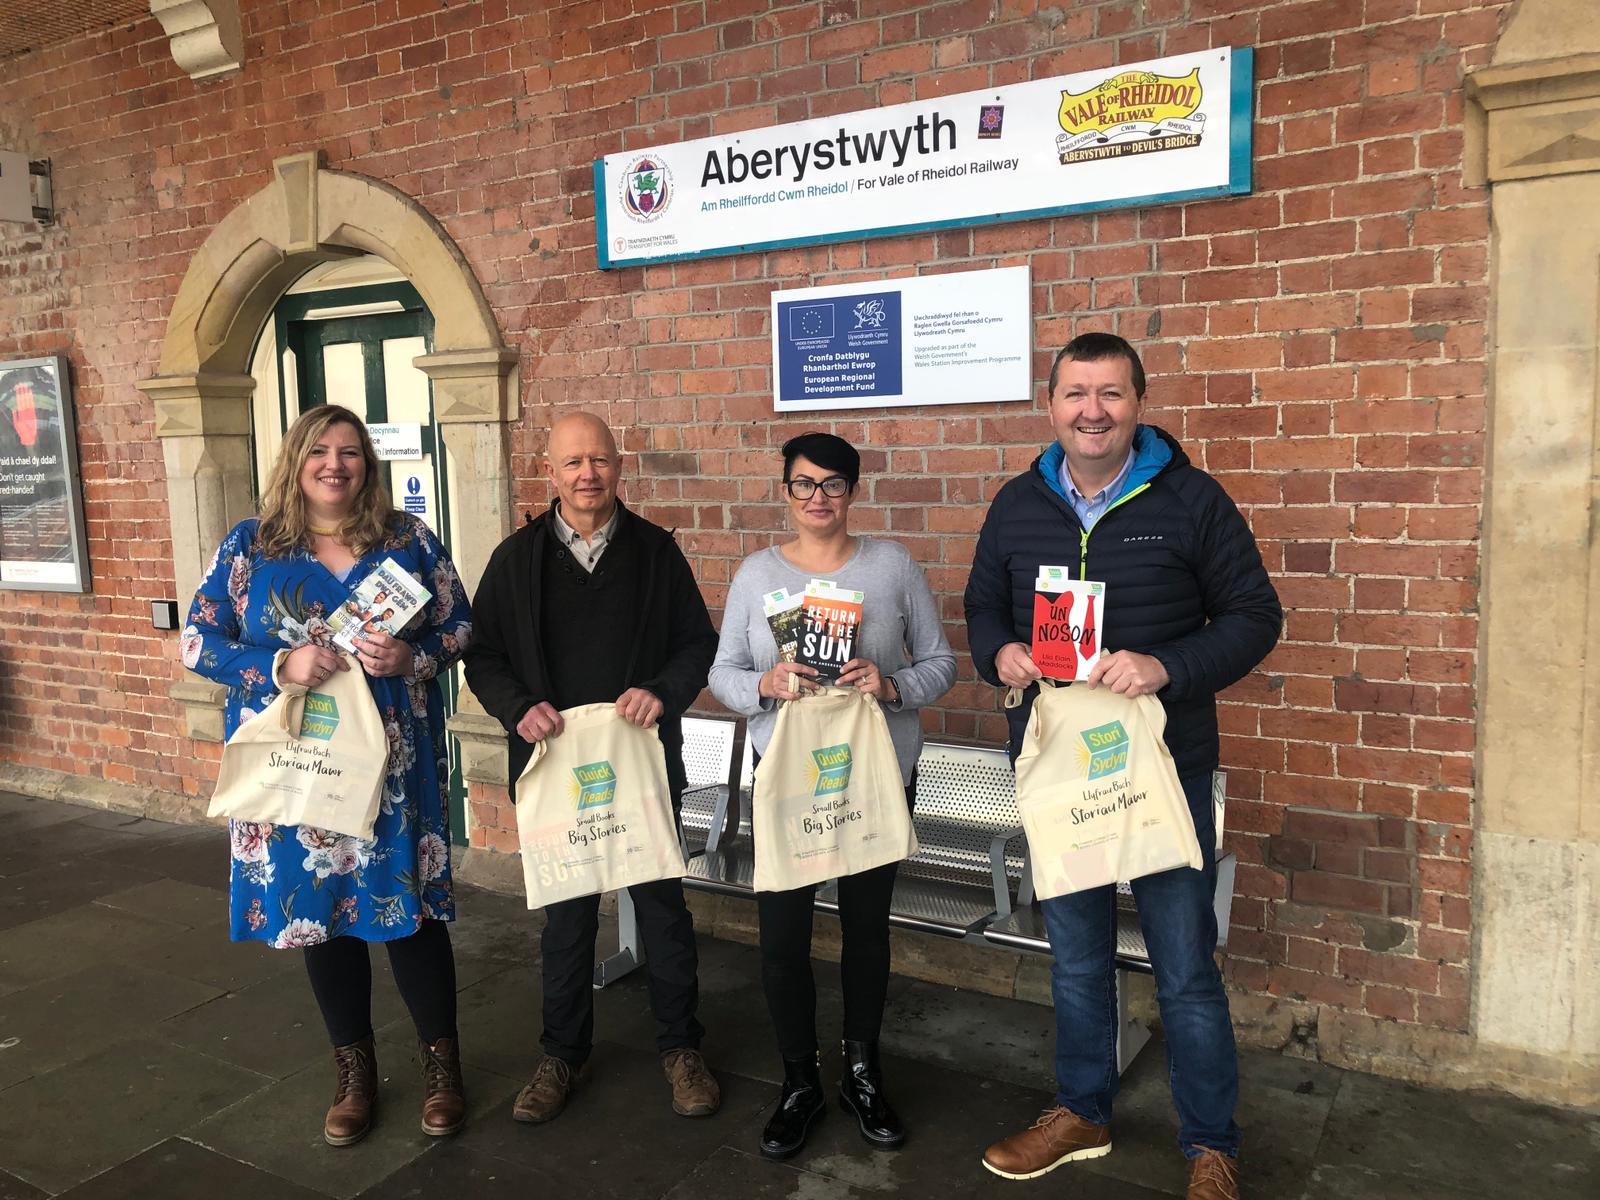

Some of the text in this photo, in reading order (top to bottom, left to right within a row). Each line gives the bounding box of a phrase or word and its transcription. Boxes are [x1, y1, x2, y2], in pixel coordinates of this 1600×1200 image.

[1121, 74, 1138, 83] THE
[1064, 83, 1197, 127] VALE OF RHEIDOL
[1098, 106, 1156, 126] RAILWAY
[1121, 124, 1137, 132] CWM
[1167, 121, 1193, 132] RHEIDOL
[701, 111, 957, 187] Aberystwyth
[1063, 144, 1122, 163] ABERYSTWYTH
[1132, 138, 1163, 153] DEVIL'S
[1165, 134, 1198, 147] BRIDGE
[701, 201, 718, 212] Am
[719, 189, 776, 210] Rheilffordd
[778, 188, 805, 202] Cwm
[807, 181, 849, 198] Rheidol
[857, 178, 877, 191] For
[879, 174, 905, 188] Vale
[907, 170, 919, 183] of
[922, 165, 967, 181] Rheidol
[970, 157, 1020, 174] Railway
[984, 317, 1003, 325] Cymru
[874, 331, 889, 339] Cymru
[947, 328, 966, 336] Cymru
[862, 338, 889, 346] Government
[914, 345, 940, 354] Upgraded
[948, 343, 959, 352] part
[808, 351, 870, 363] Cronfa Datblygu
[931, 351, 968, 359] Government's
[951, 358, 988, 366] Improvement
[988, 355, 1021, 364] Programme
[803, 361, 876, 373] Rhanbarthol Ewrop
[804, 373, 876, 385] European Regional
[804, 382, 876, 394] Development Fund
[370, 427, 400, 436] Docynnau
[385, 447, 420, 456] Information
[0, 455, 10, 466] aid
[14, 473, 25, 484] get
[25, 471, 46, 484] caught
[378, 570, 394, 585] DAU
[375, 580, 393, 596] DWY
[807, 605, 857, 624] RETURN
[1050, 605, 1068, 621] UN
[806, 619, 822, 633] TO
[828, 623, 855, 639] THE
[1038, 623, 1096, 646] NOSON
[802, 633, 852, 663] SUN
[1038, 660, 1074, 670] Maddocks
[306, 697, 334, 713] Stori
[301, 718, 334, 737] Sydyn
[1088, 726, 1122, 747] Stori
[286, 741, 331, 758] Llyfrau Bach
[818, 748, 850, 767] Quick
[268, 751, 344, 777] Storiau Mawr
[1091, 751, 1128, 773] Sydyn
[578, 764, 612, 783] Quick
[583, 787, 613, 804] Reads
[1082, 777, 1132, 802] Llyfrau Bach
[812, 798, 851, 815] Small Books
[1070, 804, 1117, 826] Storiau
[1117, 790, 1149, 810] Mawr
[576, 811, 616, 827] Small Books
[803, 810, 862, 835] Big Stories
[568, 823, 627, 847] Big Stories
